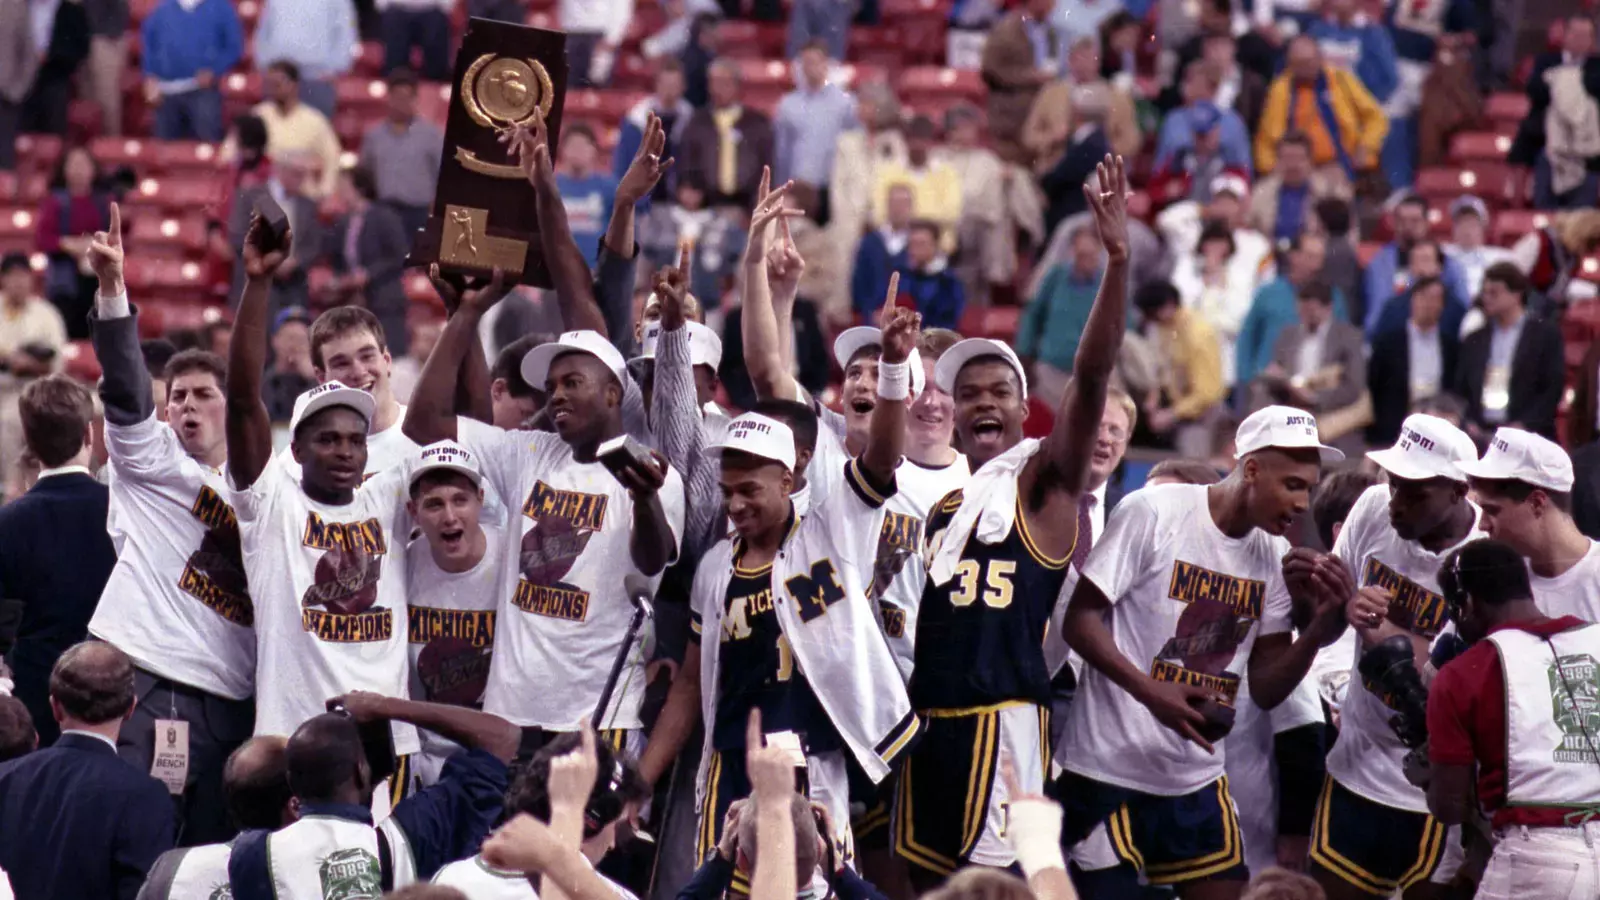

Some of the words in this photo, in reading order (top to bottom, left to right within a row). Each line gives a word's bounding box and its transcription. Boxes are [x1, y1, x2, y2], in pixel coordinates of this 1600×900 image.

[741, 420, 757, 430] DID
[757, 423, 771, 435] IT!
[1286, 416, 1305, 426] JUST
[1420, 437, 1435, 451] IT!
[421, 447, 441, 460] JUST
[442, 446, 458, 456] DID
[460, 450, 471, 462] IT!
[438, 455, 452, 463] #1
[784, 557, 846, 624] M
[950, 560, 1017, 609] 35
[1170, 562, 1264, 620] MICHIGAN
[513, 581, 588, 621] AMPIONS
[720, 588, 773, 643] MICH
[408, 606, 496, 647] MICHIGA
[156, 758, 186, 769] BENCH
[330, 861, 368, 879] 1989
